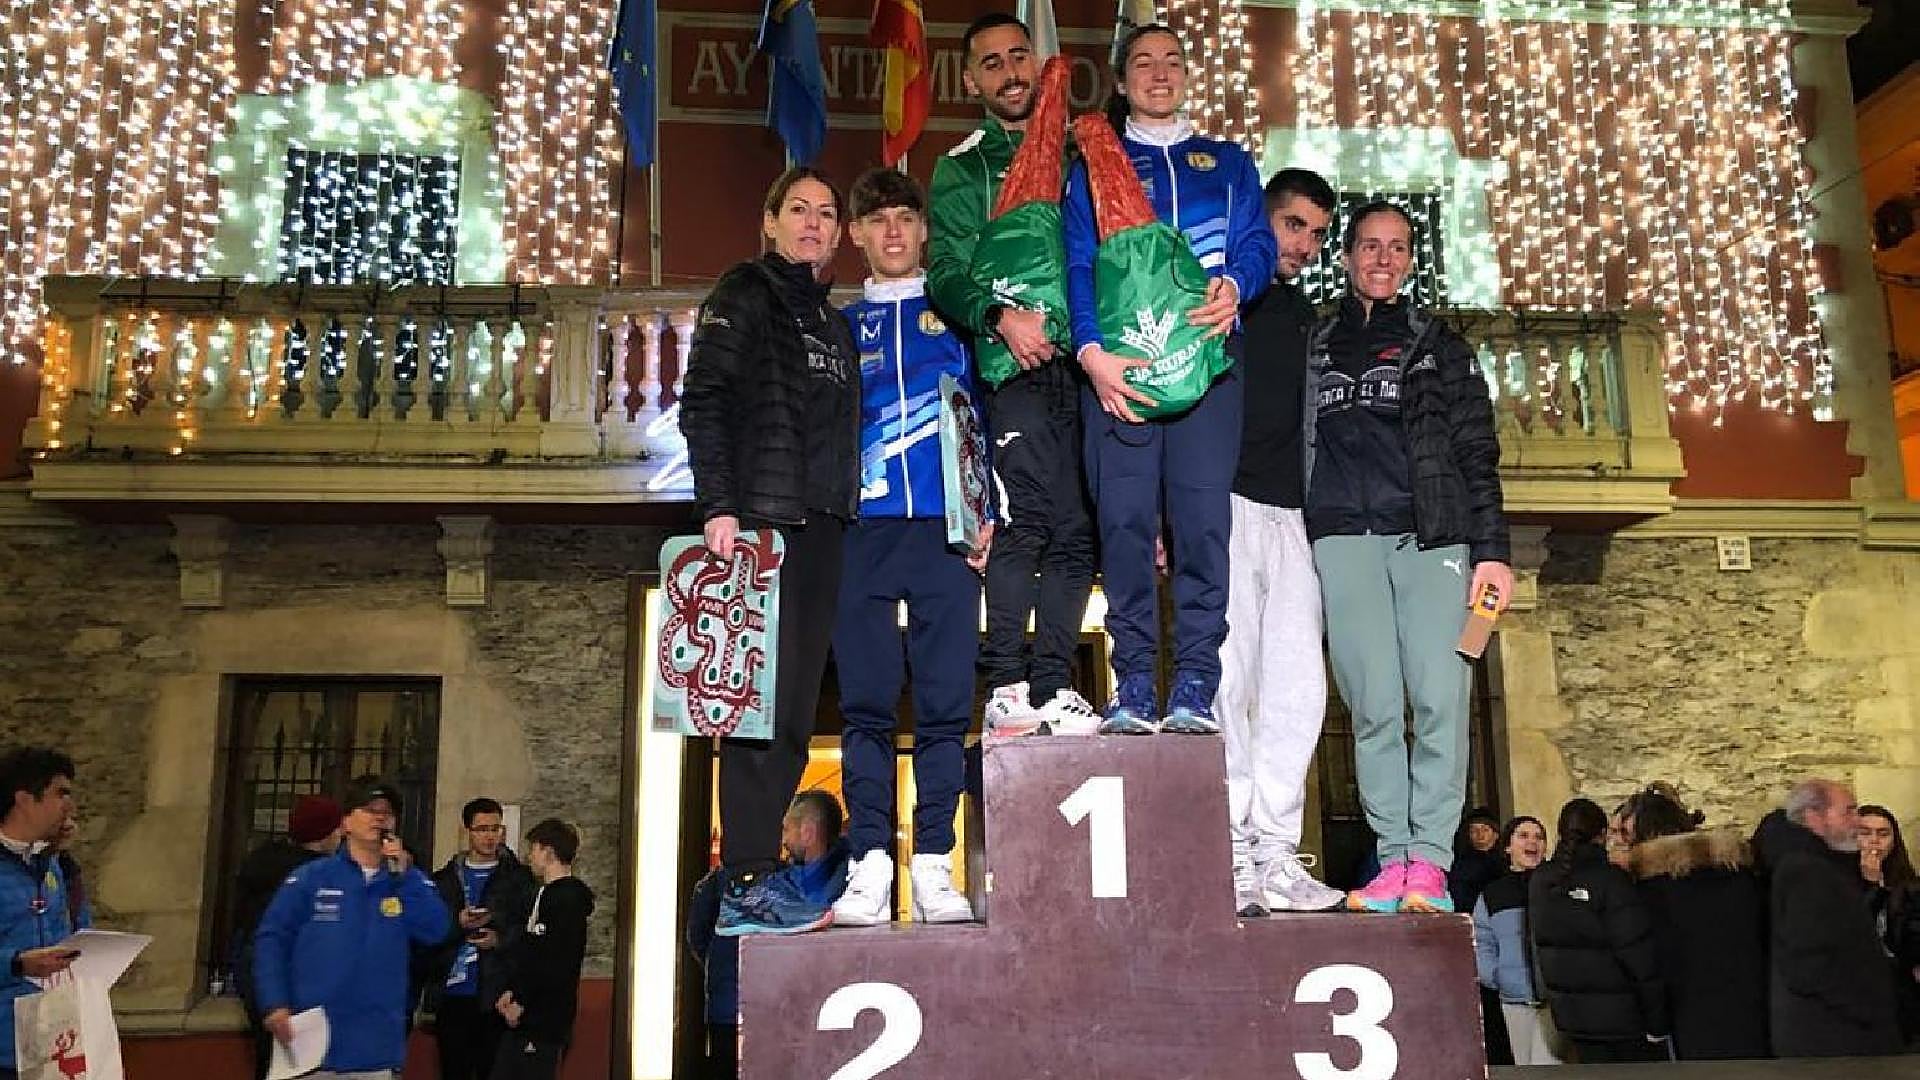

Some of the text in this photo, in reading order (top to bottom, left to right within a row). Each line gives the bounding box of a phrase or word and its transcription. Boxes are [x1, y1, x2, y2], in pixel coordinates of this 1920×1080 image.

[1059, 776, 1128, 898] 1
[817, 983, 923, 1080] 2
[1295, 964, 1398, 1080] 3
